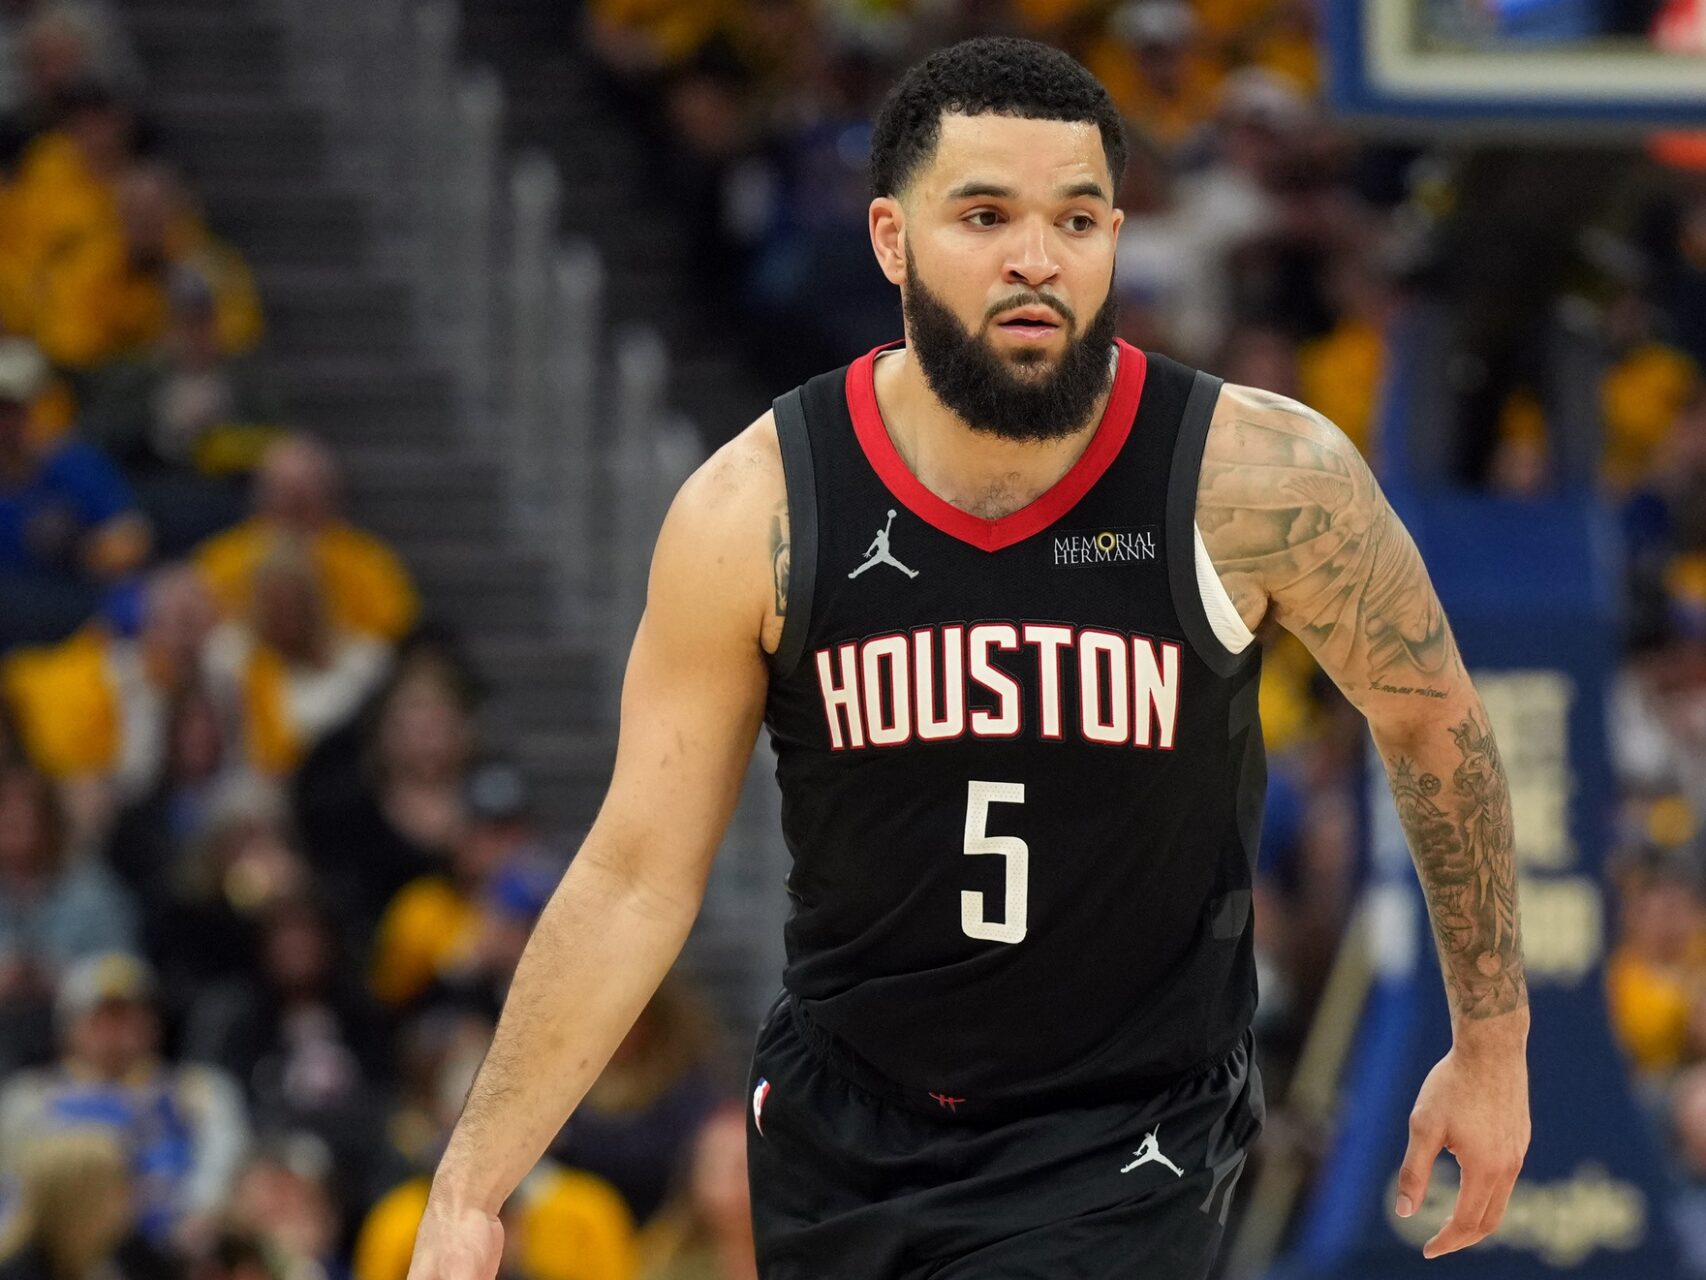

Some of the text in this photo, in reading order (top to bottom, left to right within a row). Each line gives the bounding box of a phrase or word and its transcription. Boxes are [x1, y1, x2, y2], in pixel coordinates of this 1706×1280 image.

[1054, 531, 1156, 552] MEMORIAL
[1054, 545, 1156, 565] HERMANN
[815, 621, 1181, 751] HOUSTON
[961, 780, 1029, 944] 5
